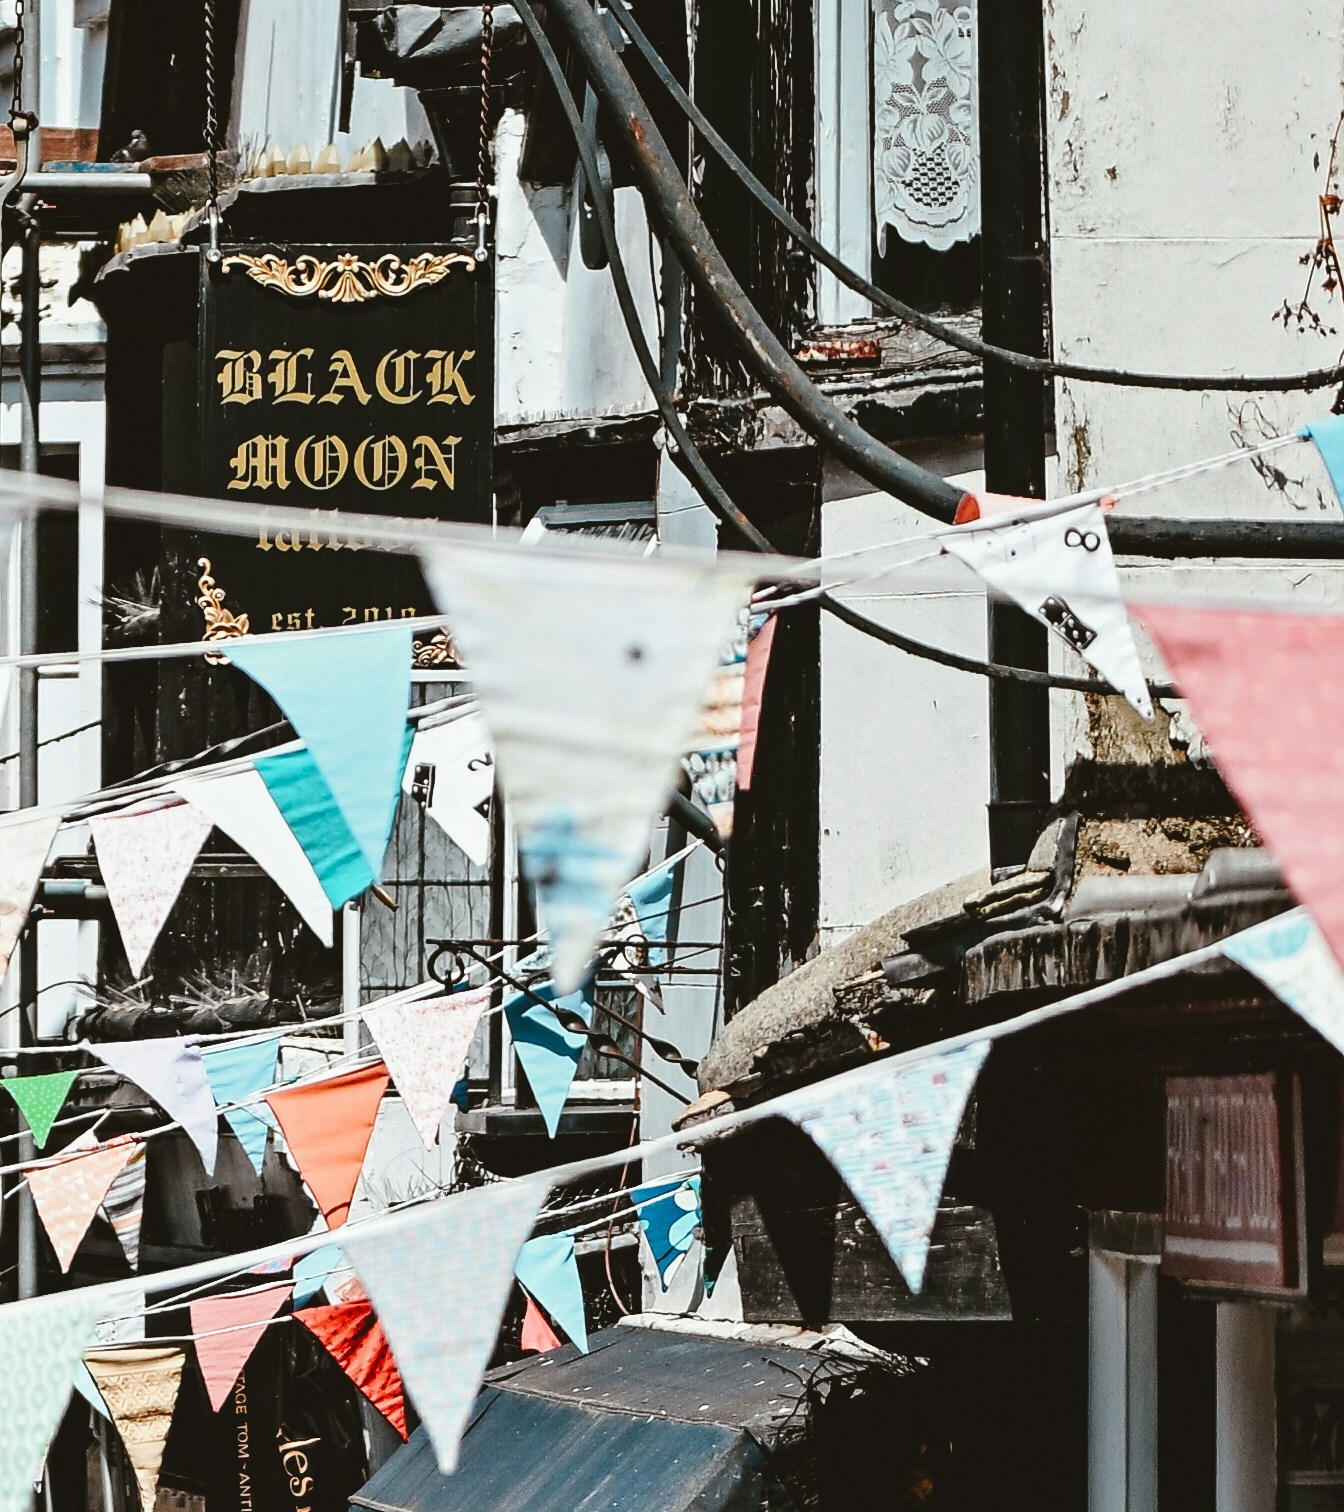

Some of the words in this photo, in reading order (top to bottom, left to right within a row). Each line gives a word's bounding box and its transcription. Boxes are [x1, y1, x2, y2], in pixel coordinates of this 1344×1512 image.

[214, 348, 477, 407] BLACK
[228, 433, 464, 493] MOON
[235, 1368, 249, 1415] TAGE
[235, 1421, 250, 1459] TOM
